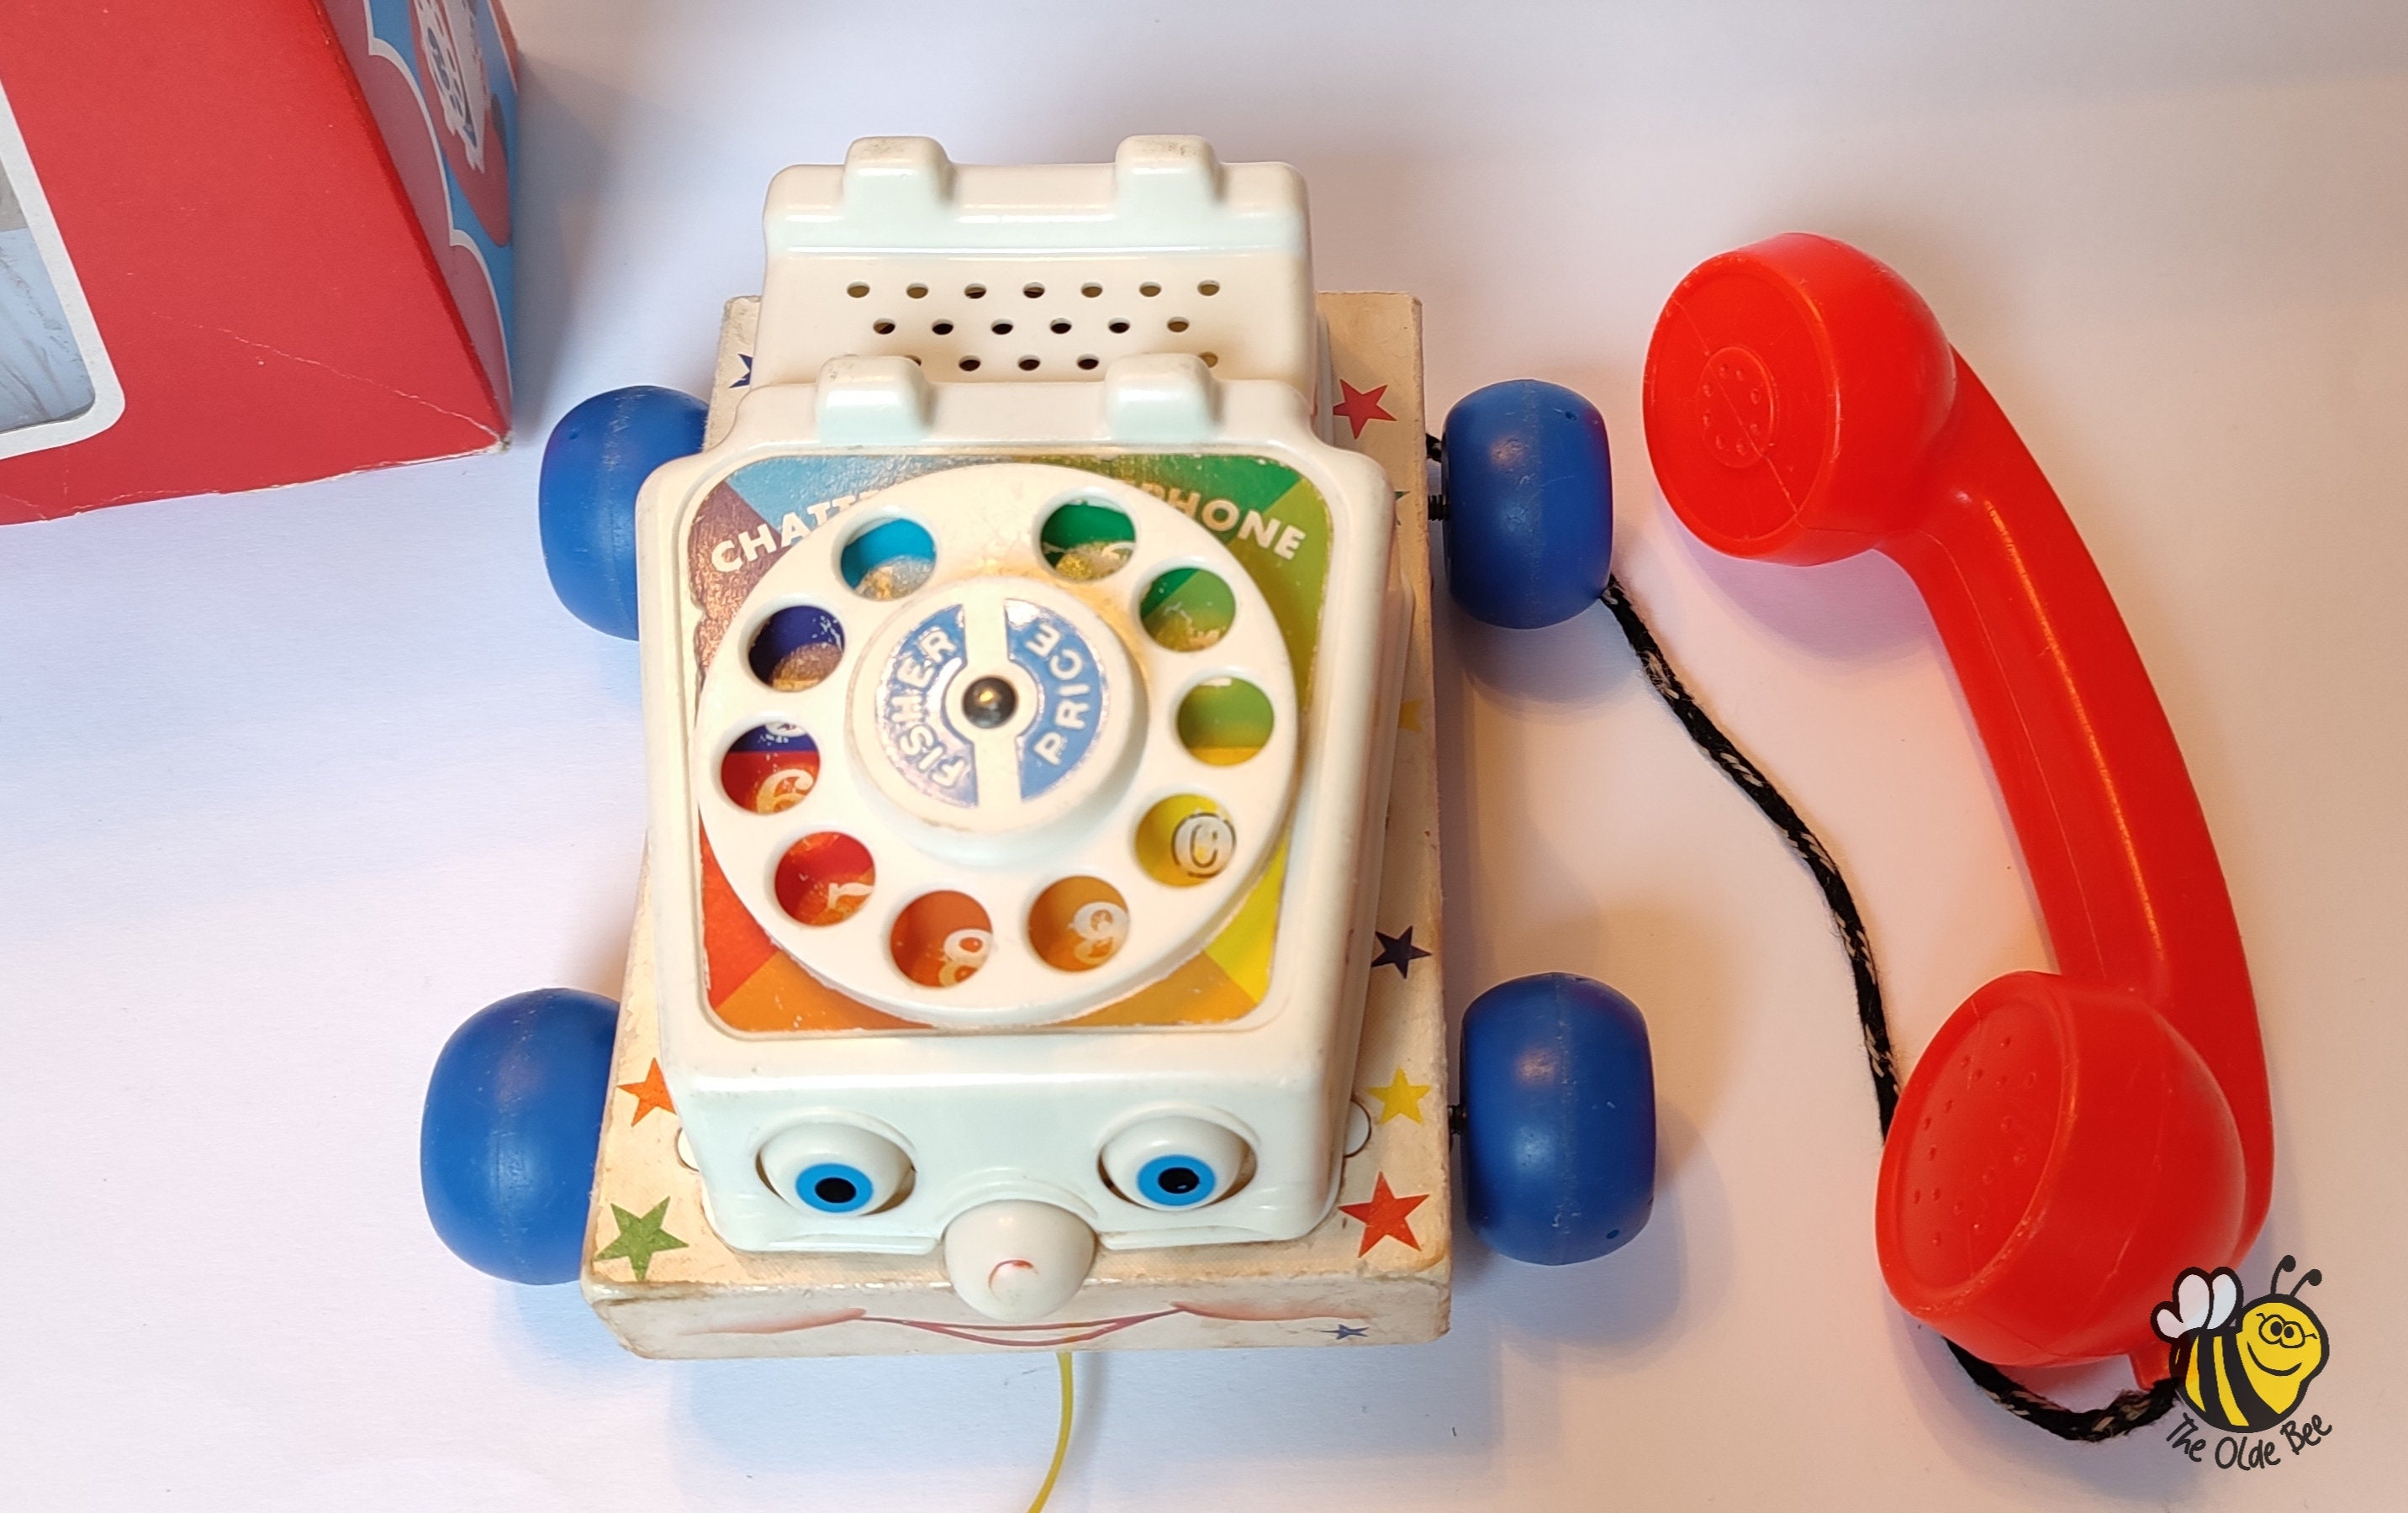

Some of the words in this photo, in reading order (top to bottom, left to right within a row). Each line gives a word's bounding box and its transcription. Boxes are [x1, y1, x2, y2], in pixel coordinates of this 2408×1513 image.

[711, 490, 878, 572] CHATT
[890, 625, 965, 788] FISHER
[1026, 623, 1091, 766] PRICE
